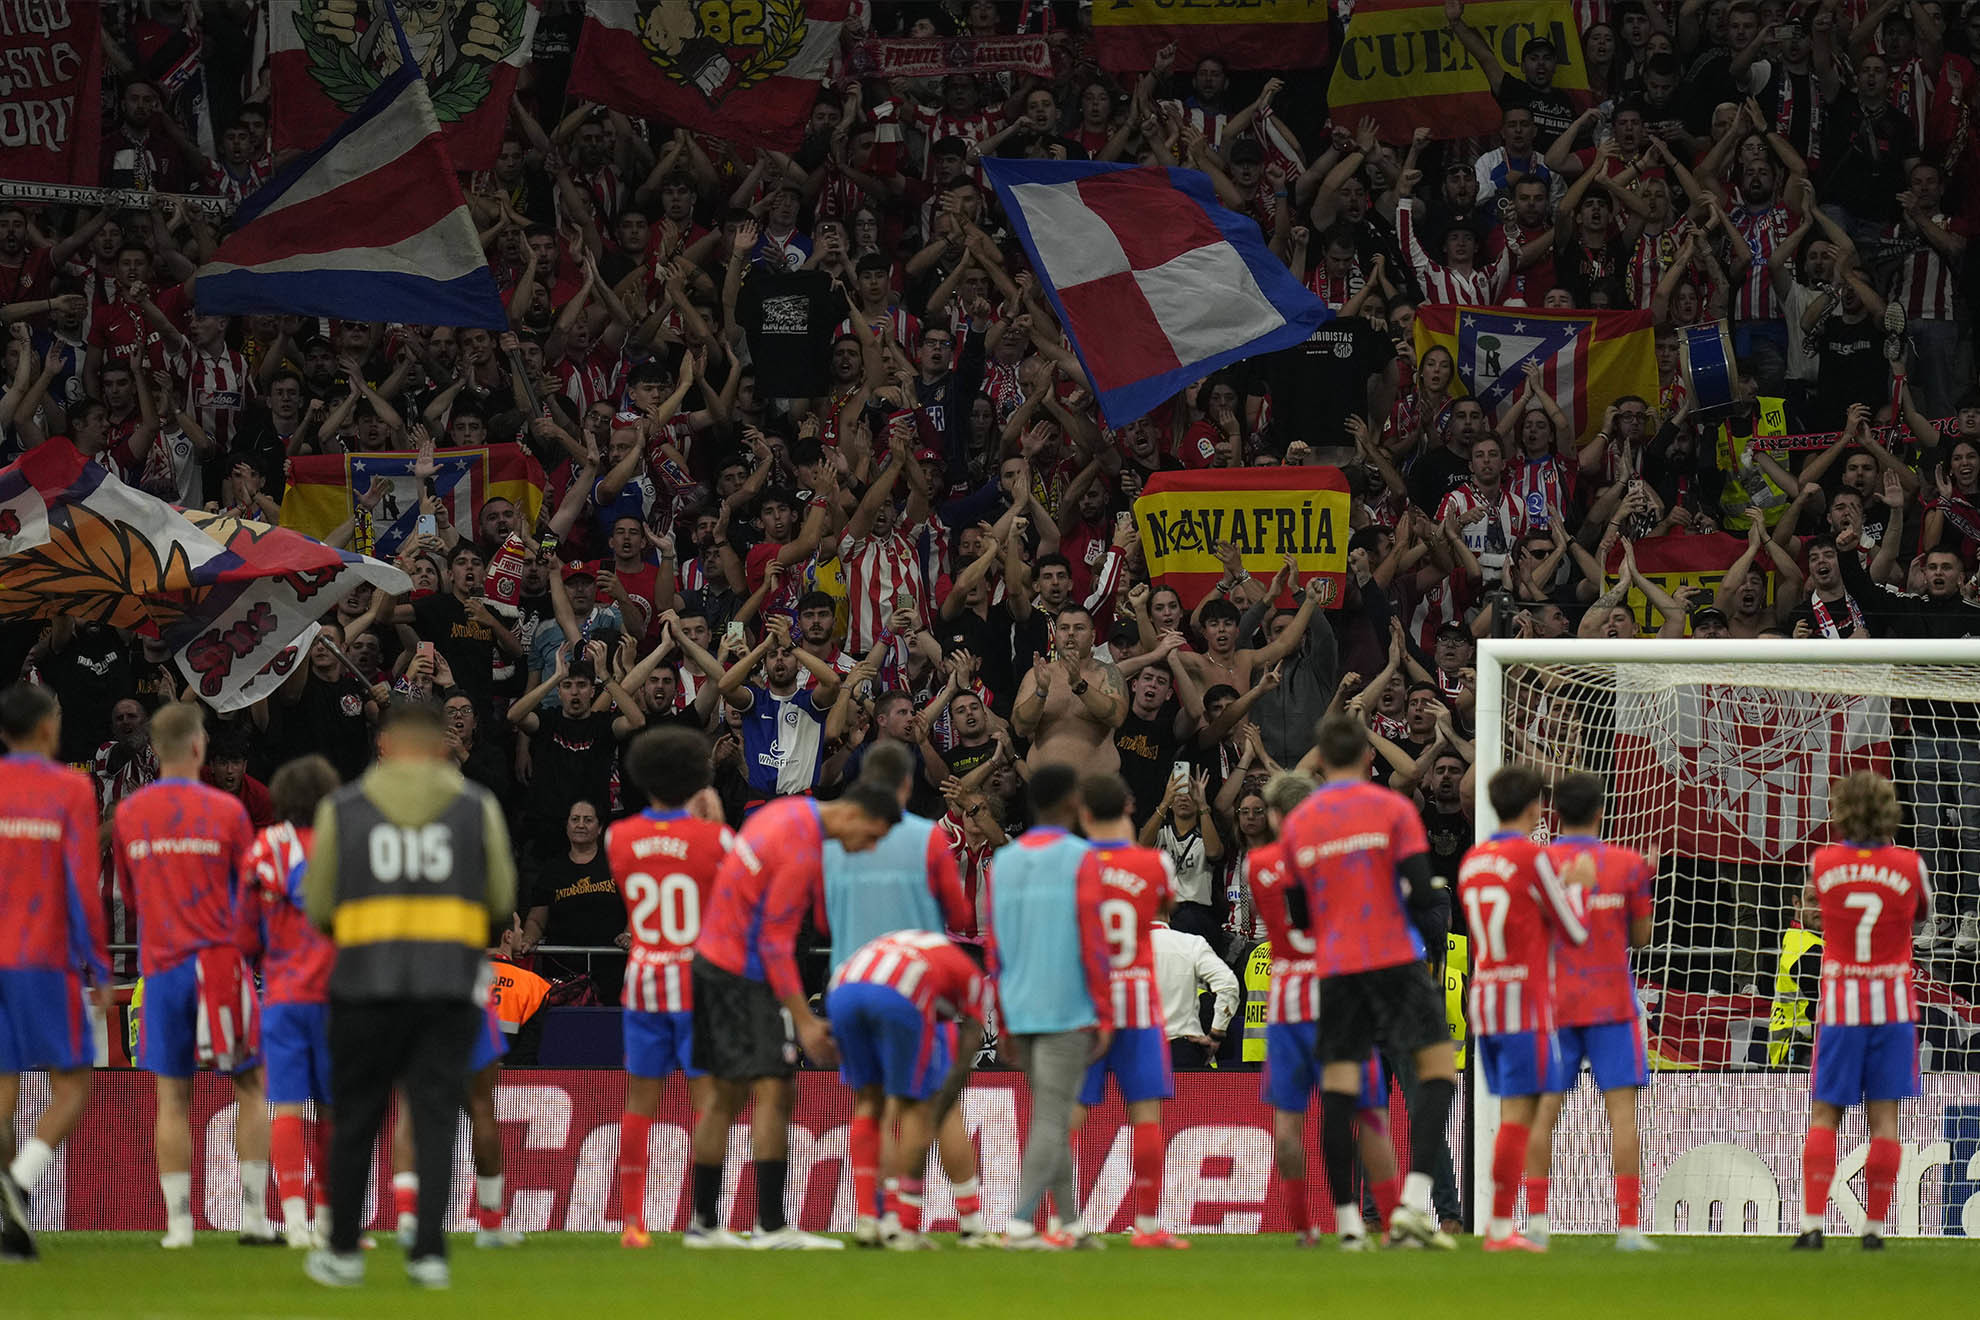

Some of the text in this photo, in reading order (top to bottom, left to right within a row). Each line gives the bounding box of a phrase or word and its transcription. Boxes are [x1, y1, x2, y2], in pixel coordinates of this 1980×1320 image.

[884, 46, 939, 68] FRENTE
[499, 558, 522, 575] FRENTE
[369, 822, 454, 883] 015
[624, 872, 700, 946] 20
[1463, 885, 1512, 963] 17
[1844, 891, 1883, 963] 7
